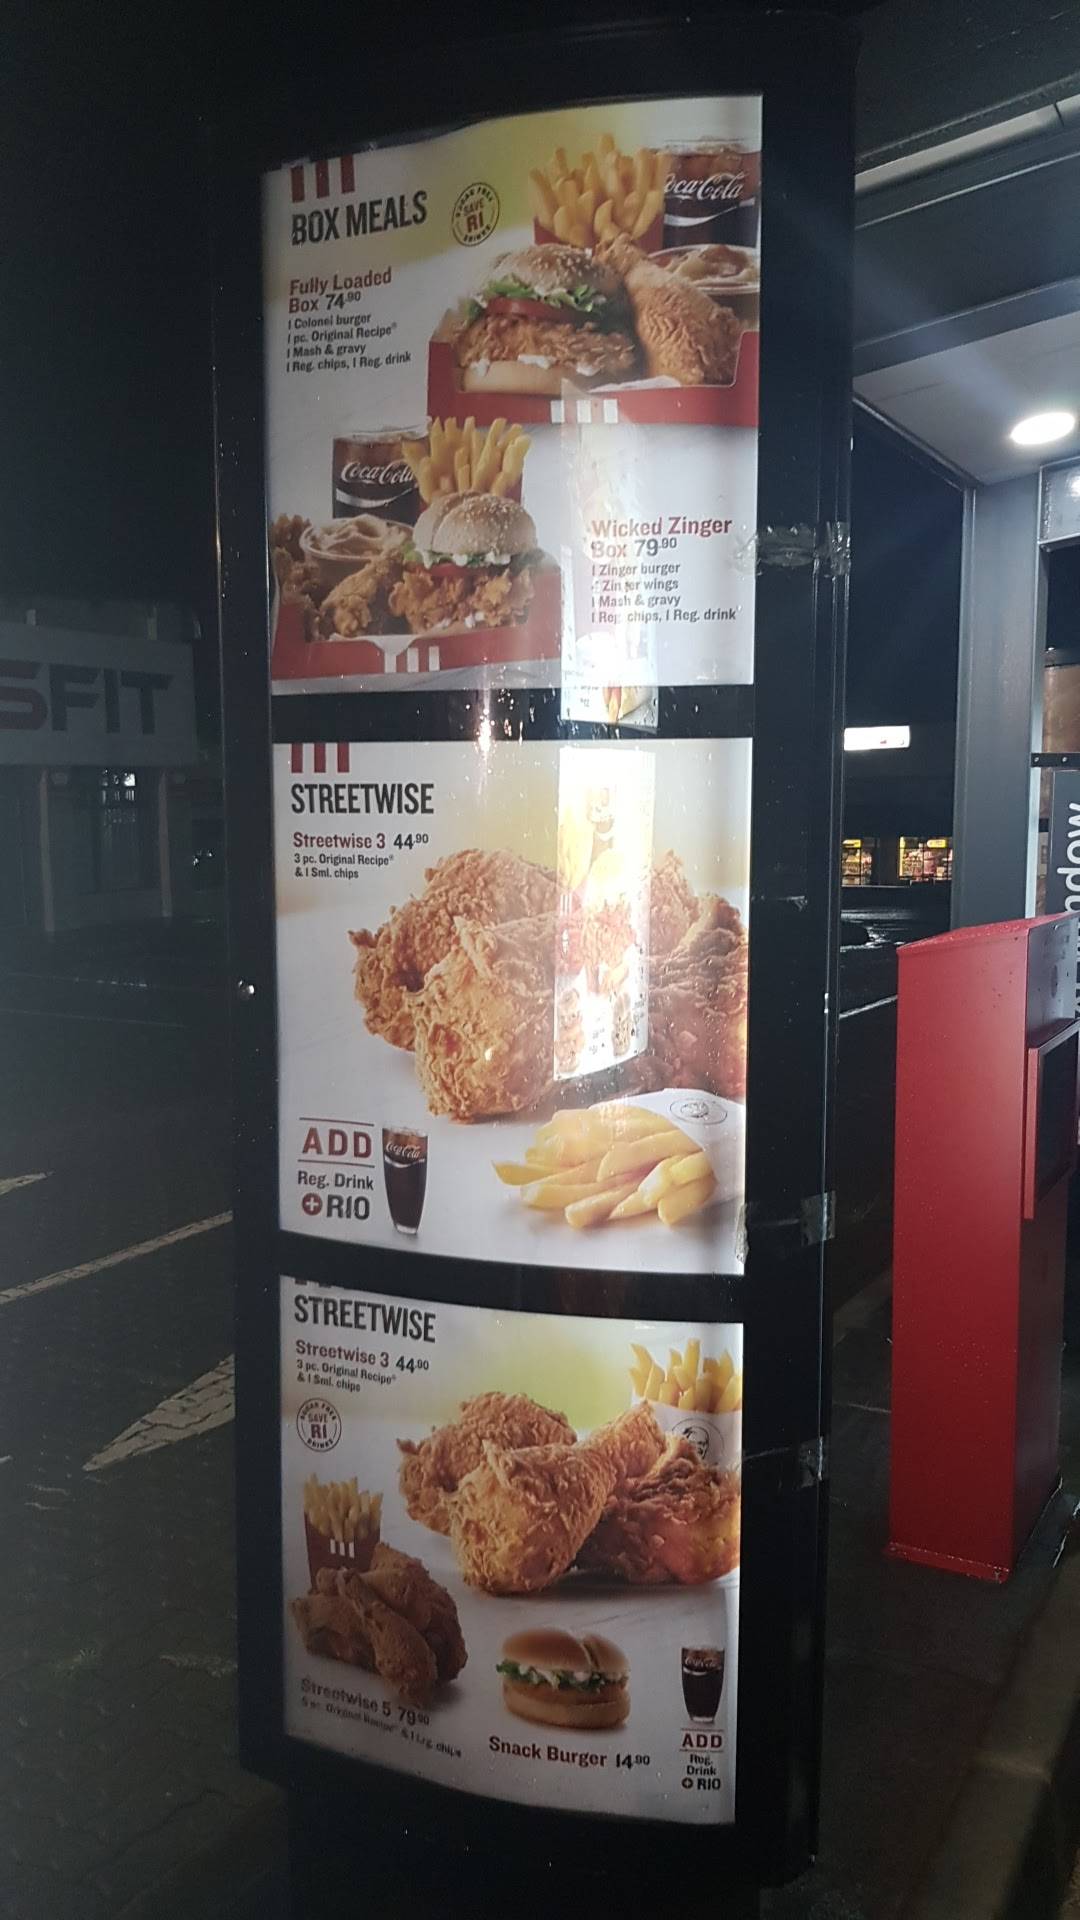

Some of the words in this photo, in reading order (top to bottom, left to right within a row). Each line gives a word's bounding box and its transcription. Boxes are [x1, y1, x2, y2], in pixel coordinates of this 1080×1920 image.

[292, 207, 340, 246] BOX
[346, 190, 427, 237] MEALS
[289, 277, 328, 296] Fully
[333, 266, 392, 291] Loaded
[288, 297, 319, 314] Box
[294, 315, 333, 329] Colonel
[336, 314, 371, 327] burger
[311, 329, 353, 342] Original
[293, 345, 322, 358] Mash
[325, 344, 334, 355] &
[336, 344, 366, 356] gravy
[318, 359, 350, 371] chips,
[385, 350, 411, 365] drink
[591, 516, 662, 537] Wicked
[668, 516, 732, 538] Zinger
[591, 541, 627, 558] Box
[599, 564, 637, 577] Zinger
[641, 563, 681, 576] burger
[644, 578, 679, 591] wings
[599, 595, 631, 607] Mash
[634, 595, 645, 606] &
[647, 595, 681, 608] gravy
[703, 607, 736, 620] drink
[291, 783, 434, 814] STREETWISE
[293, 832, 372, 849] Streetwise
[376, 833, 386, 849] 3
[294, 853, 300, 864] 3
[303, 855, 317, 866] pc.
[319, 854, 355, 866] Original
[295, 867, 303, 877] &
[311, 868, 332, 878] Sml.
[334, 868, 359, 880] chips
[302, 1127, 372, 1158] ADD
[298, 1170, 329, 1190] Reg.
[334, 1173, 374, 1190] Drink
[294, 1294, 435, 1343] STREETWISE
[296, 1339, 375, 1365] Streetwise
[380, 1352, 389, 1368] 3
[297, 1359, 303, 1369] 3
[306, 1362, 319, 1374] pc.
[322, 1364, 358, 1378] Original
[297, 1373, 305, 1383] &
[314, 1374, 334, 1387] Sml.
[336, 1379, 360, 1393] chips
[308, 1413, 328, 1423] SAVE
[302, 1677, 378, 1712] Streetwise
[382, 1701, 392, 1717] 5
[682, 1733, 723, 1748] ADD
[489, 1735, 541, 1760] Snack
[547, 1743, 607, 1768] Burger
[686, 1764, 717, 1777] Drink
